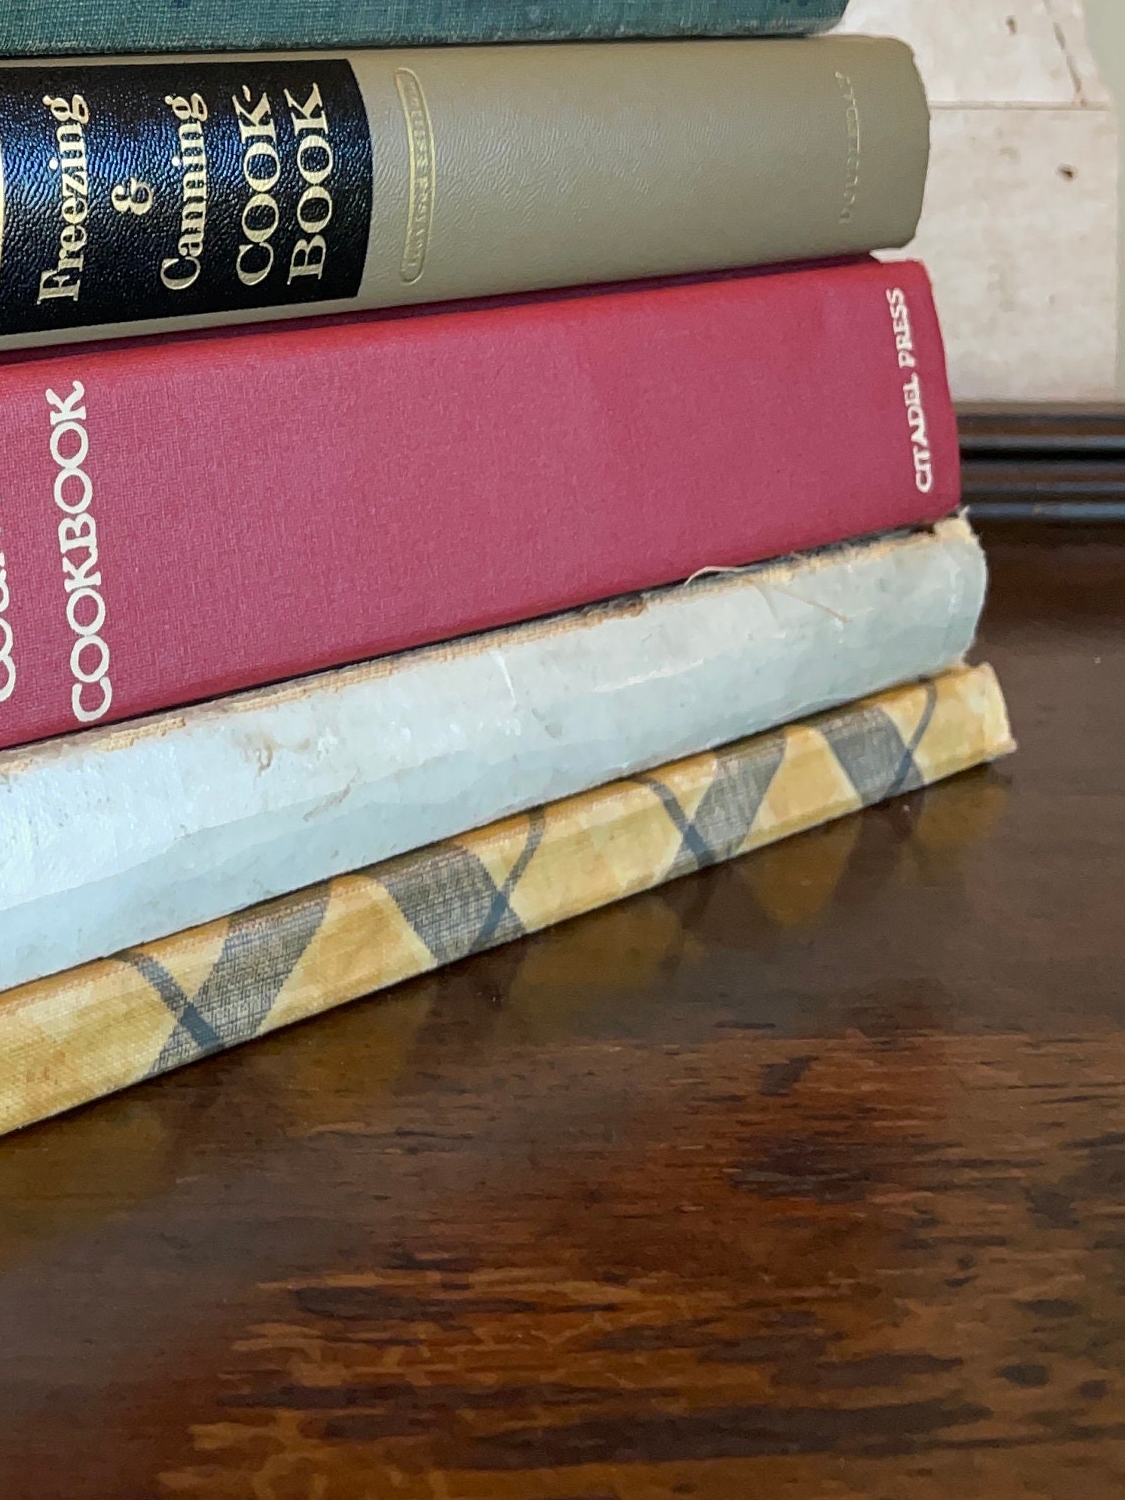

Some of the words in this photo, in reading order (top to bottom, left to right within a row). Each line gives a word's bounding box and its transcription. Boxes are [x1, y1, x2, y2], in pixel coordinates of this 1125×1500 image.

[37, 94, 96, 304] Freezing
[111, 177, 154, 216] &
[161, 93, 209, 289] Canning
[232, 85, 281, 285] COOK-
[284, 83, 333, 285] BOOK
[886, 289, 915, 367] PRESS
[903, 373, 932, 492] CITADEL
[45, 380, 112, 722] COOKBOOK
